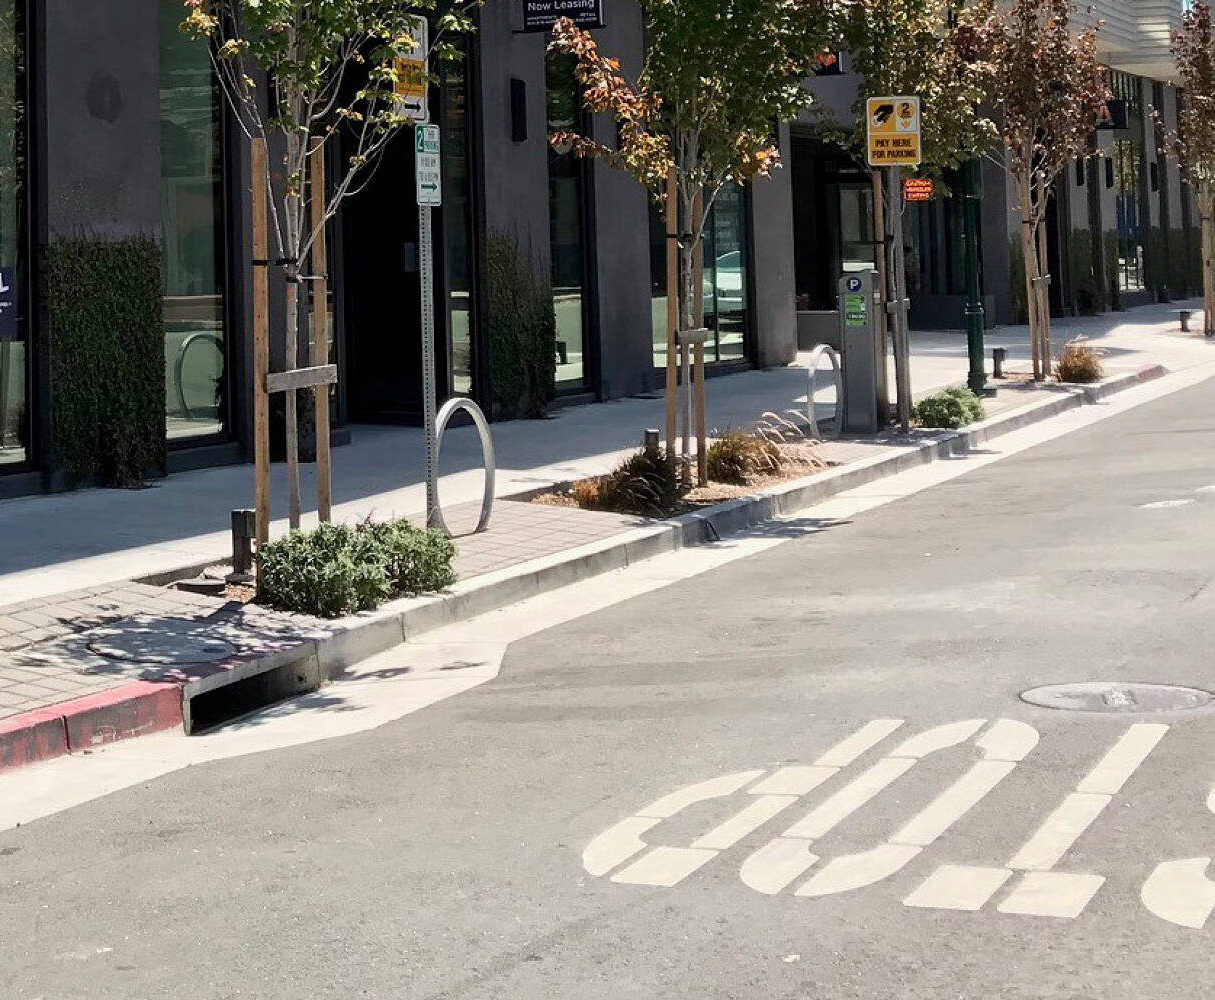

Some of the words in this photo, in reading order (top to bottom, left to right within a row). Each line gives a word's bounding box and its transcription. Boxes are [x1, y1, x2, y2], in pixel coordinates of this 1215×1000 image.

[527, 2, 552, 11] Now
[902, 103, 910, 114] 2
[876, 138, 890, 147] PAY
[892, 138, 912, 147] HERE
[872, 150, 886, 159] FOR
[887, 149, 916, 158] PARKING
[850, 279, 859, 290] P
